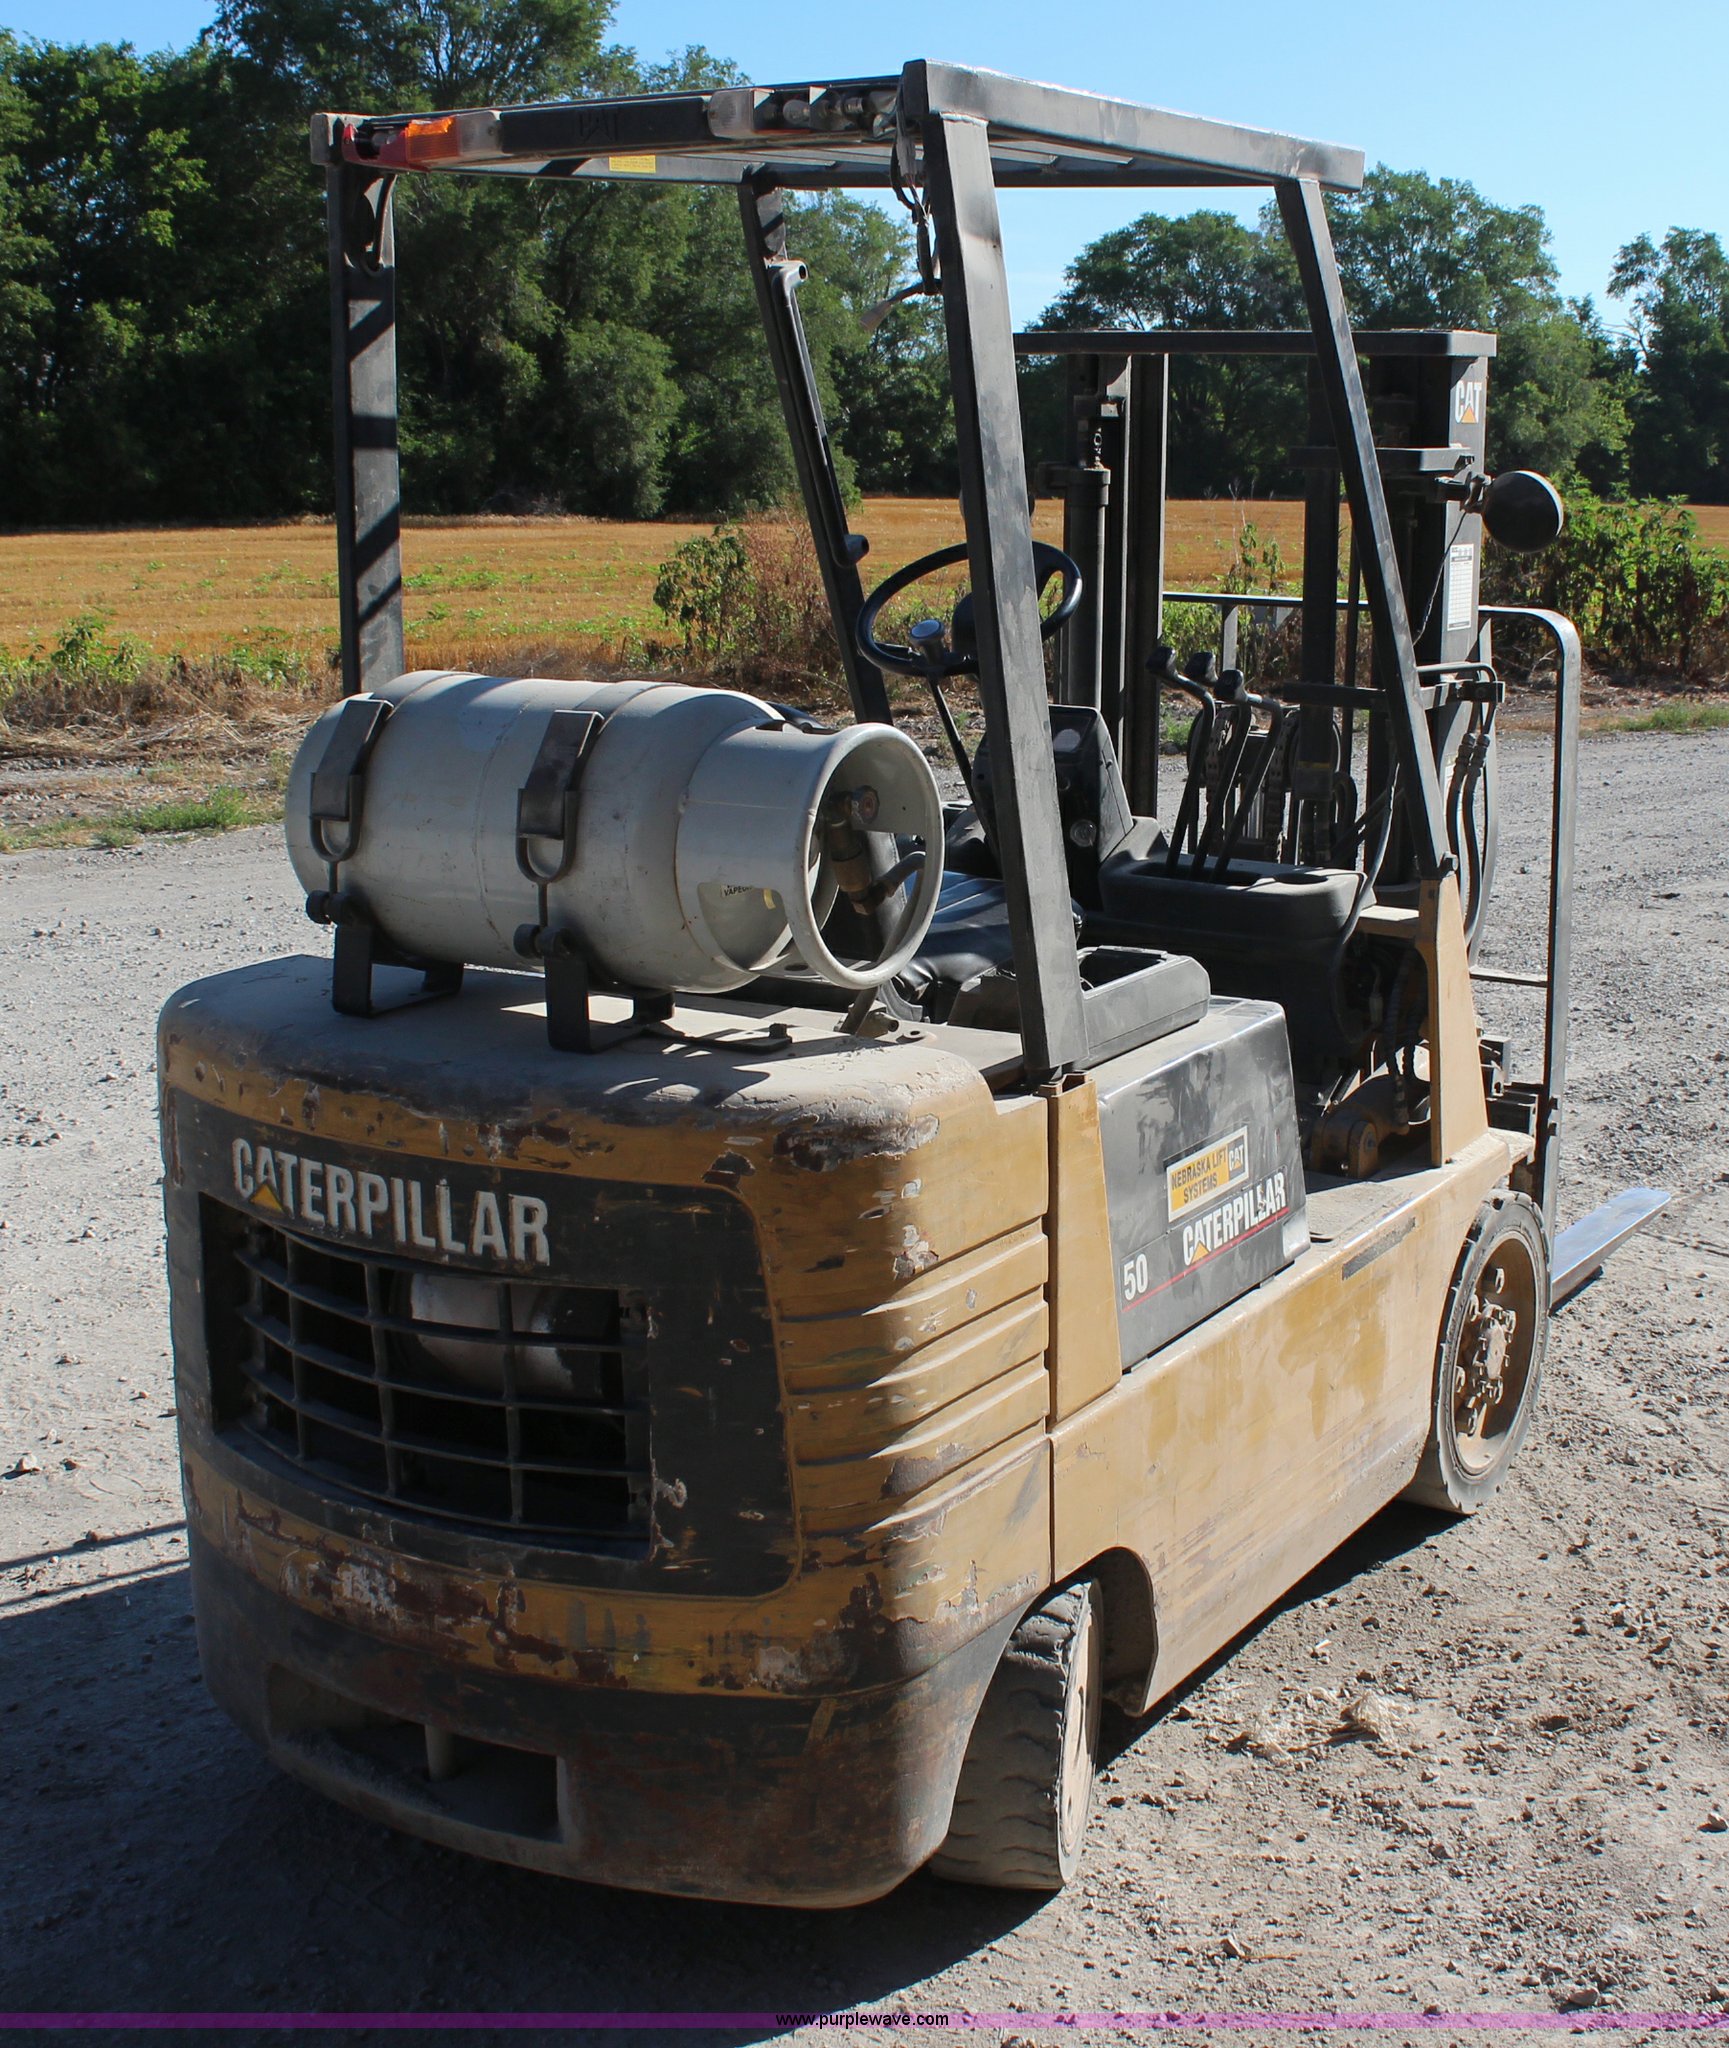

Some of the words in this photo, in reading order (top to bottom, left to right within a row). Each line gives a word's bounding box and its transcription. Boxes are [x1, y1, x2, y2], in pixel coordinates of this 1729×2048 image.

[1455, 380, 1482, 423] CAT
[1171, 1157, 1211, 1190] NEBRASKA
[1212, 1147, 1227, 1168] LIFT
[1228, 1144, 1244, 1171] CAT
[232, 1138, 550, 1266] CATERPILLAR
[1183, 1172, 1218, 1204] SYSTEMS
[1182, 1171, 1287, 1266] CATERPILLAR
[1123, 1253, 1149, 1301] 50
